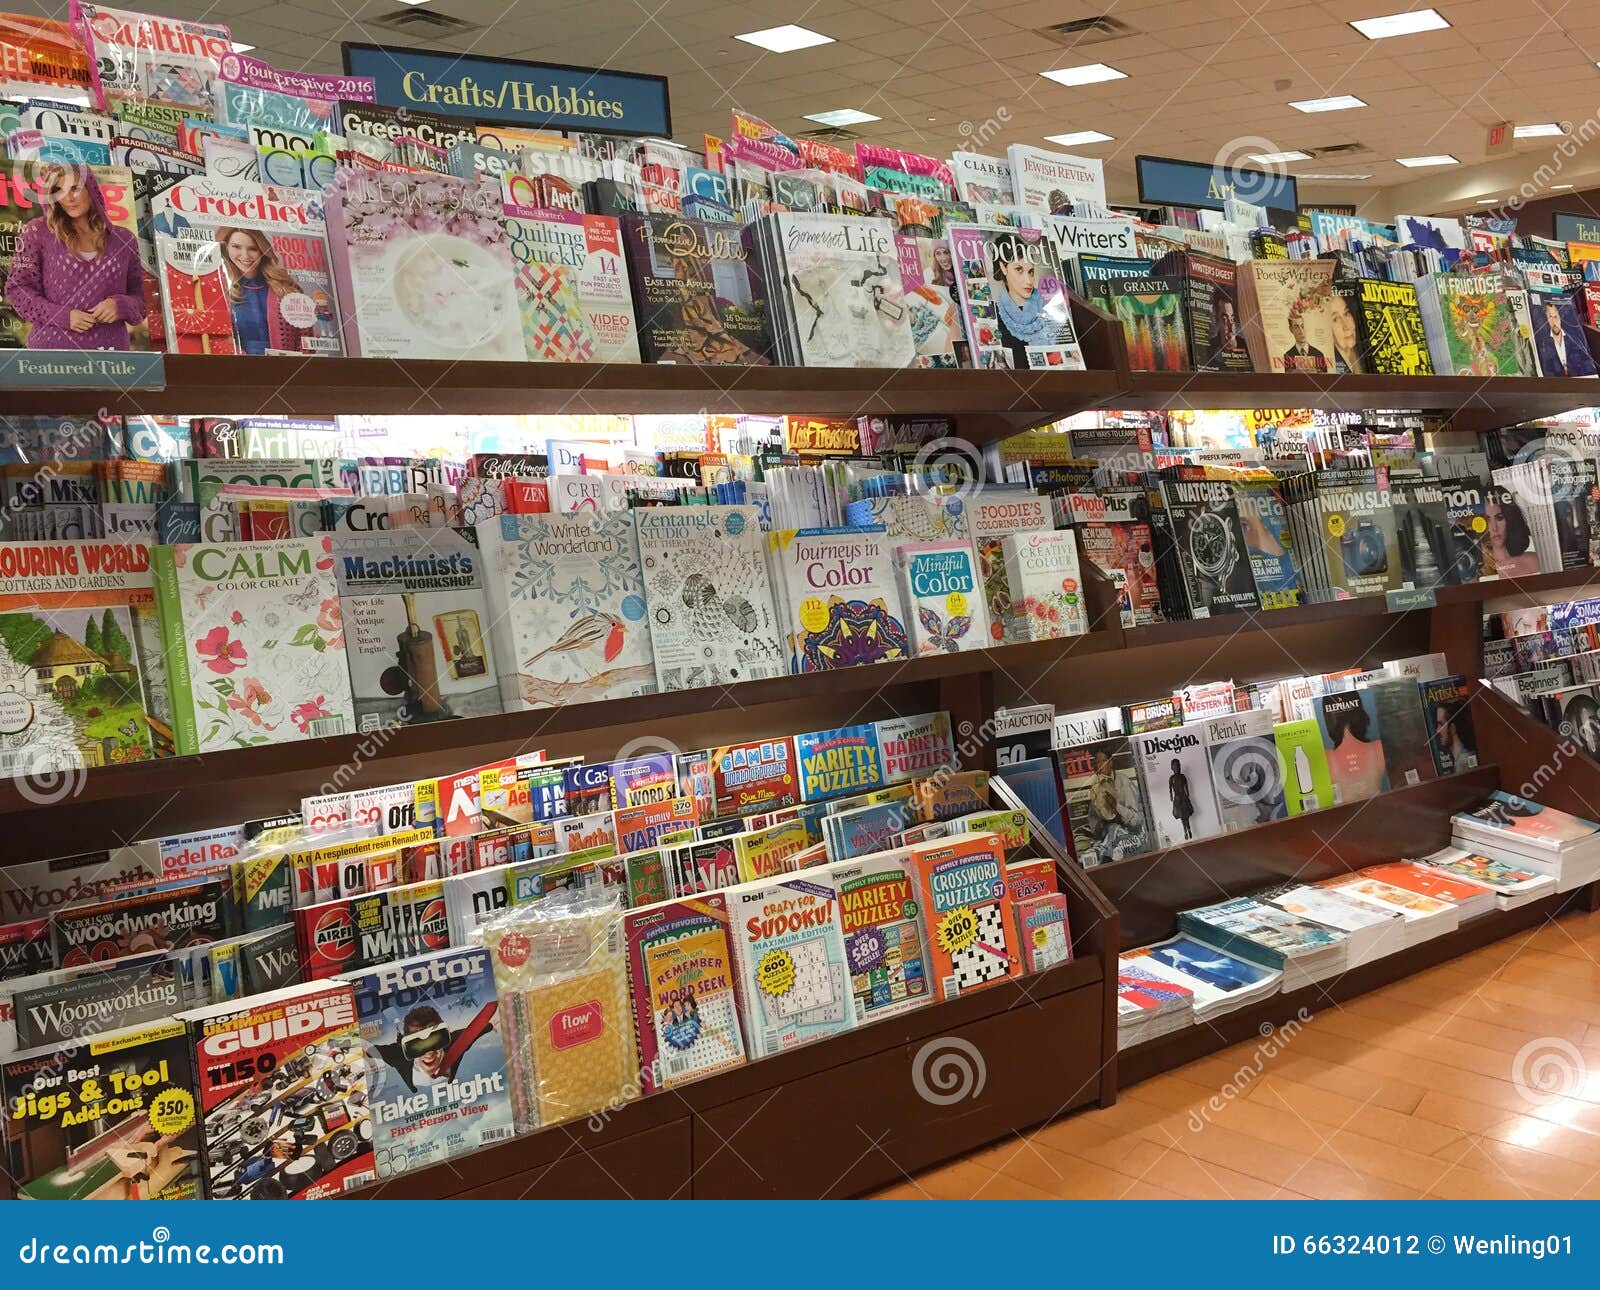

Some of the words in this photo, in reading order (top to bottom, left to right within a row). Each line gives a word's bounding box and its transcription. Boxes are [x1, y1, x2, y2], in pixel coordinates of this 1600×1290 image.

[91, 15, 228, 59] Quilting
[31, 61, 57, 78] WALL
[338, 80, 372, 93] 2016
[402, 71, 624, 119] Crafts/Hobbies
[1023, 156, 1057, 179] JEWISH
[1058, 165, 1096, 184] REVIEW
[1206, 175, 1237, 200] Art
[170, 184, 306, 224] Crochet
[180, 228, 213, 241] SPARKLE
[506, 219, 583, 245] Quilting
[842, 224, 889, 254] Life
[511, 239, 586, 270] Quickly
[955, 234, 1051, 268] crochet
[600, 256, 618, 275] 14
[1123, 280, 1170, 292] GRANTA
[1362, 284, 1417, 304] JUXTAPOZ
[589, 313, 630, 326] VIDEO
[17, 359, 94, 376] Featured
[97, 360, 136, 376] Title
[1338, 412, 1362, 425] White
[809, 422, 861, 450] Treasure
[1199, 453, 1219, 461] PREFIX
[1221, 452, 1241, 460] PHOTO
[522, 486, 545, 502] ZEN
[1175, 482, 1228, 503] WATCHES
[1322, 494, 1365, 513] NIKON
[1366, 491, 1391, 509] SLR
[640, 511, 718, 530] Zentangle
[980, 502, 1042, 520] FOODIE'S
[551, 524, 590, 539] Winter
[976, 518, 1020, 530] COLORING
[1021, 516, 1046, 526] BOOK
[640, 528, 689, 539] STUDIO
[535, 540, 612, 556] Wonderland
[794, 542, 862, 565] Journeys
[864, 542, 879, 558] in
[81, 544, 150, 573] WORLD
[192, 549, 312, 582] CALM
[343, 552, 473, 580] Machinist's
[916, 557, 963, 574] Mindful
[56, 579, 75, 590] AND
[77, 576, 126, 589] GARDENS
[405, 576, 474, 590] WORKSHOP
[807, 559, 873, 589] Color
[914, 572, 974, 595] Color
[216, 579, 257, 591] COLOR
[259, 579, 300, 589] CREATE
[352, 599, 369, 607] New
[352, 608, 364, 616] for
[366, 608, 377, 616] an
[804, 599, 822, 611] 112
[353, 617, 385, 627] Antique
[356, 636, 381, 644] Steam
[1146, 703, 1173, 720] BRUSH
[1325, 699, 1360, 713] ELEPHANT
[1056, 722, 1089, 741] FINE
[1209, 722, 1247, 742] PleinAir
[802, 738, 819, 746] Dell
[883, 735, 948, 757] VARIETY
[1144, 734, 1200, 755] Disegno.
[722, 744, 786, 771] GAMES
[803, 746, 876, 773] VARIETY
[885, 753, 951, 776] PUZZLES
[1066, 752, 1094, 773] art
[585, 768, 608, 785] Cas
[725, 770, 750, 786] WORLD
[762, 762, 787, 779] PUZZLES
[806, 765, 880, 794] PUZZLES
[630, 788, 664, 806] WORD
[673, 802, 691, 810] 370
[564, 823, 584, 832] Dell
[645, 812, 671, 825] FAMILY
[663, 836, 678, 845] Dell
[706, 828, 724, 838] Dell
[747, 837, 764, 848] Dell
[314, 851, 322, 862] A
[323, 844, 370, 859] resplendent
[371, 841, 390, 851] resin
[392, 833, 420, 848] Renault
[936, 860, 959, 873] FAMILY
[960, 853, 993, 866] FAVORITES
[844, 880, 868, 892] FAMILY
[868, 872, 903, 885] FAVORITES
[933, 861, 998, 886] CROSSWORD
[742, 891, 764, 902] Dell
[841, 882, 907, 911] VARIETY
[935, 884, 990, 909] PUZZLES
[993, 884, 1005, 897] 57
[1016, 880, 1046, 898] EASY
[357, 898, 381, 913] TELFORD
[360, 908, 380, 921] SHOW
[763, 899, 795, 917] CRAZY
[796, 894, 815, 906] FOR
[844, 901, 901, 928] PUZZLES
[904, 904, 916, 916] 56
[64, 901, 217, 945] woodworking
[358, 916, 381, 930] REPORT
[747, 900, 832, 942] SUDOKU!
[948, 913, 963, 926] OVER
[646, 925, 670, 938] FAMILY
[753, 934, 799, 951] MAXIMUM
[800, 925, 834, 939] EDITION
[855, 934, 869, 945] OVER
[944, 919, 972, 941] 300
[951, 930, 973, 946] PUZZLES!
[766, 955, 780, 963] OVER
[851, 939, 879, 962] 580
[858, 949, 882, 969] PUZZLES!
[376, 954, 487, 996] Rotor
[657, 957, 722, 984] REMEMBER
[764, 959, 786, 972] 600
[658, 984, 697, 1005] WORD
[698, 975, 727, 994] SEEK
[286, 994, 351, 1017] BUYERS
[203, 1005, 354, 1057] GUIDE
[204, 1009, 283, 1034] ULTIMATE
[561, 1012, 592, 1030] flow
[95, 1042, 110, 1051] FREE
[111, 1035, 142, 1048] Exclusive
[142, 1031, 160, 1040] Triple
[161, 1026, 183, 1035] Bonus!
[782, 1032, 796, 1042] FREE
[207, 1062, 231, 1071] OVER
[208, 1053, 276, 1083] 1150
[33, 1072, 63, 1091] Our
[67, 1064, 100, 1081] Best
[209, 1077, 254, 1092] PRODUCTS
[13, 1090, 71, 1120] Jigs
[79, 1079, 104, 1102] &
[109, 1060, 169, 1095] Tool
[371, 1094, 429, 1126] Take
[431, 1070, 504, 1106] Flight
[61, 1095, 144, 1128] Add-Ons
[158, 1100, 190, 1117] 350+
[404, 1113, 424, 1124] YOUR
[425, 1107, 448, 1119] GUIDE
[449, 1102, 459, 1111] TO
[390, 1125, 417, 1139] First
[418, 1110, 458, 1130] Person
[460, 1103, 489, 1118] View
